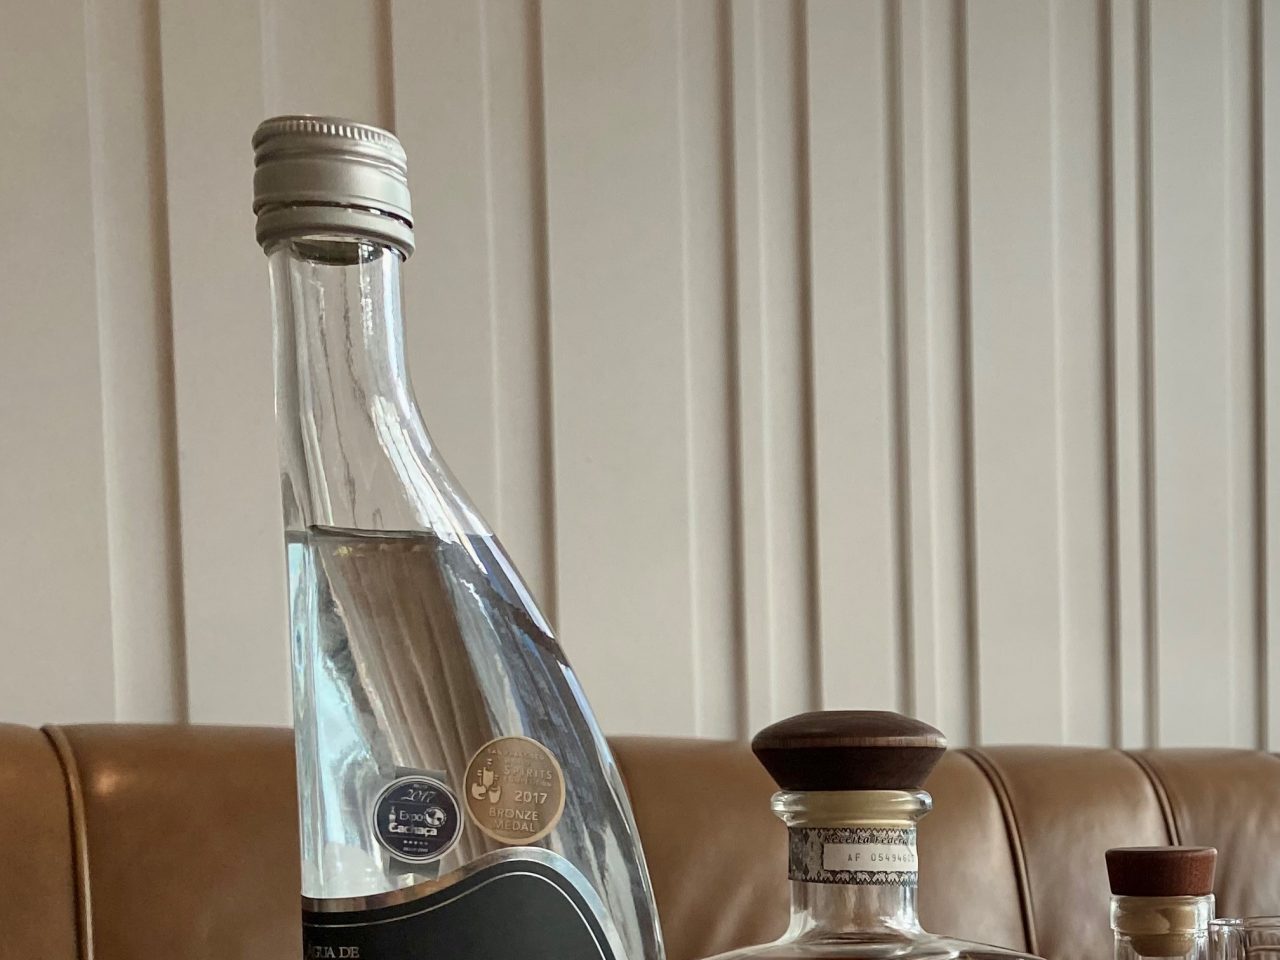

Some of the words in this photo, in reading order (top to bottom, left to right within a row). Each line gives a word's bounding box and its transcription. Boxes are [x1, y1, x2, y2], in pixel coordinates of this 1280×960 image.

[514, 790, 548, 805] 2017
[399, 810, 424, 824] Expo
[488, 807, 539, 821] BRONZE
[494, 820, 536, 833] MEDAL
[847, 853, 861, 862] AF
[338, 946, 360, 959] DE
